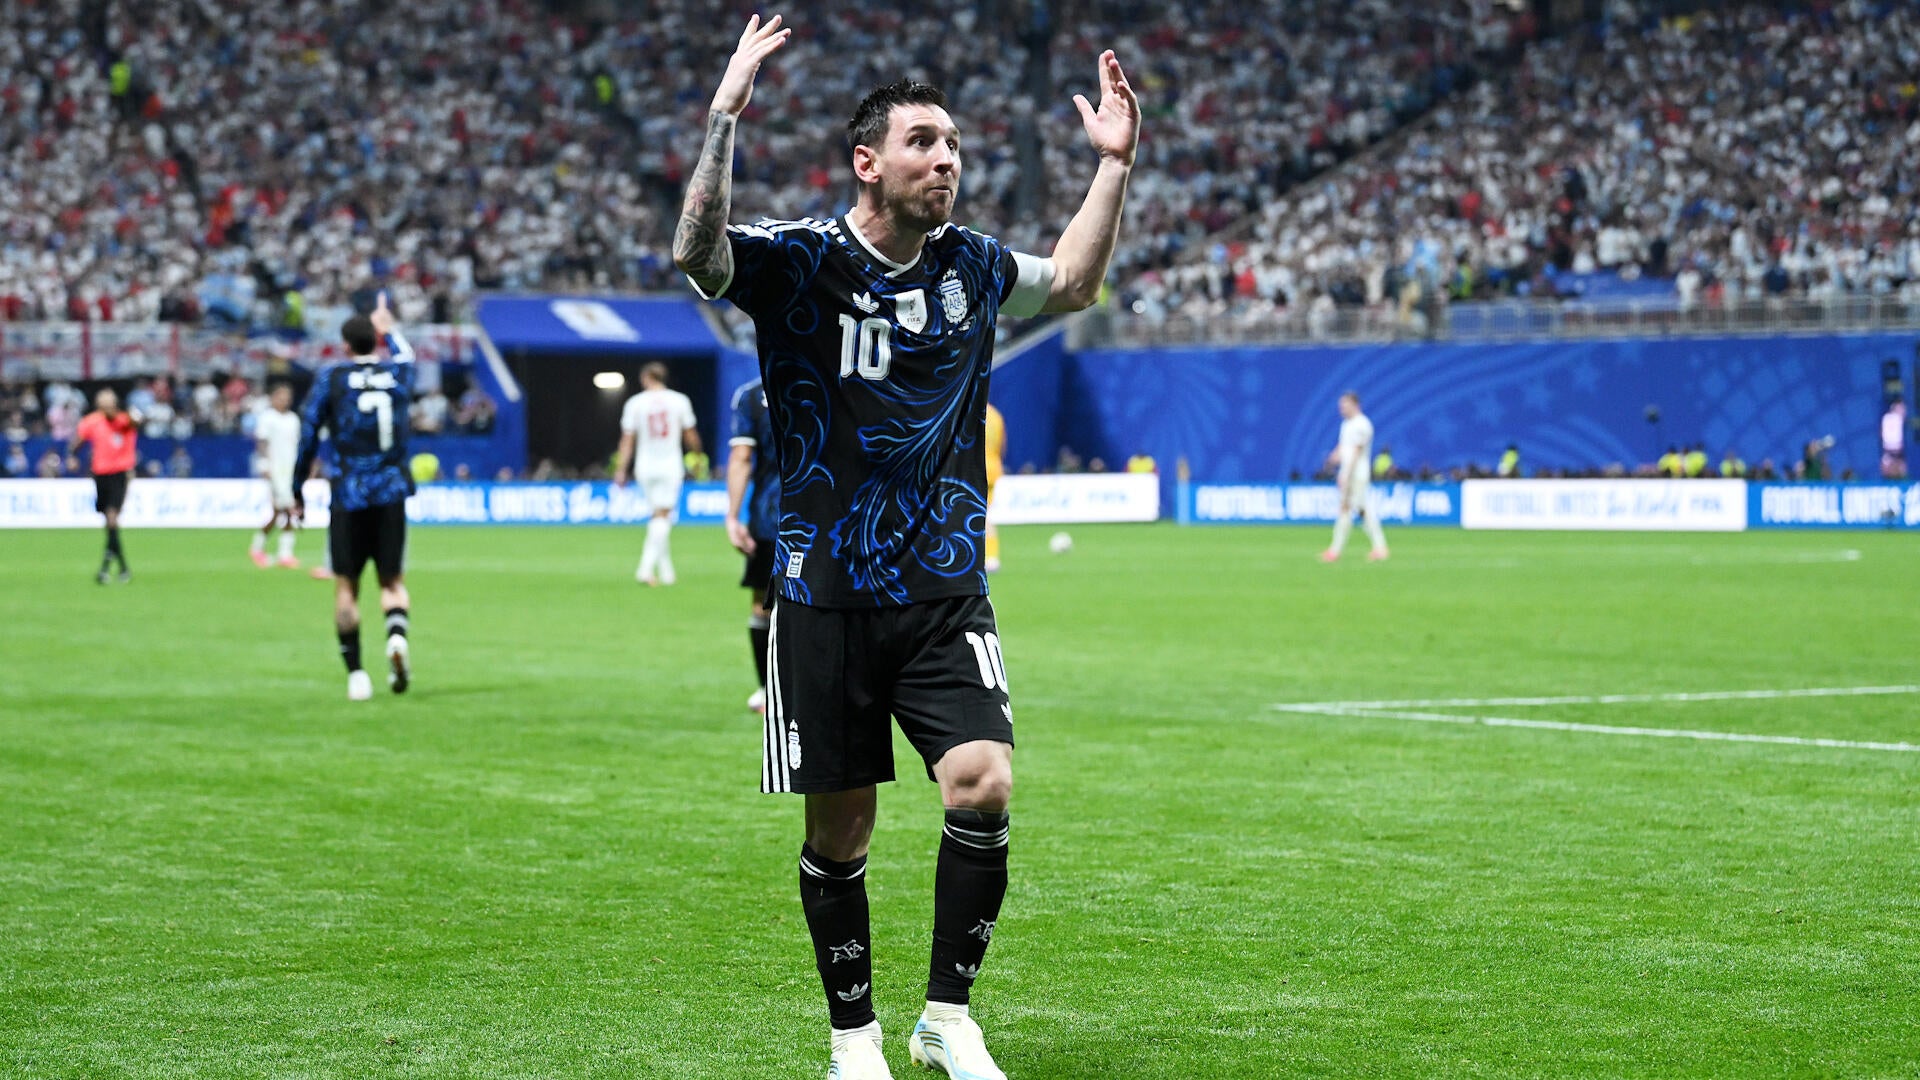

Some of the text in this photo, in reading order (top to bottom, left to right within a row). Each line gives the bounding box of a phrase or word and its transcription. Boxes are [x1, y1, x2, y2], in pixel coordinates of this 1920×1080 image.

[838, 313, 892, 381] 10
[357, 390, 393, 451] 7
[490, 486, 566, 521] UNITES
[1196, 486, 1285, 520] FOOTBALL
[1761, 486, 1841, 523] FOOTBALL
[965, 631, 1008, 695] 10
